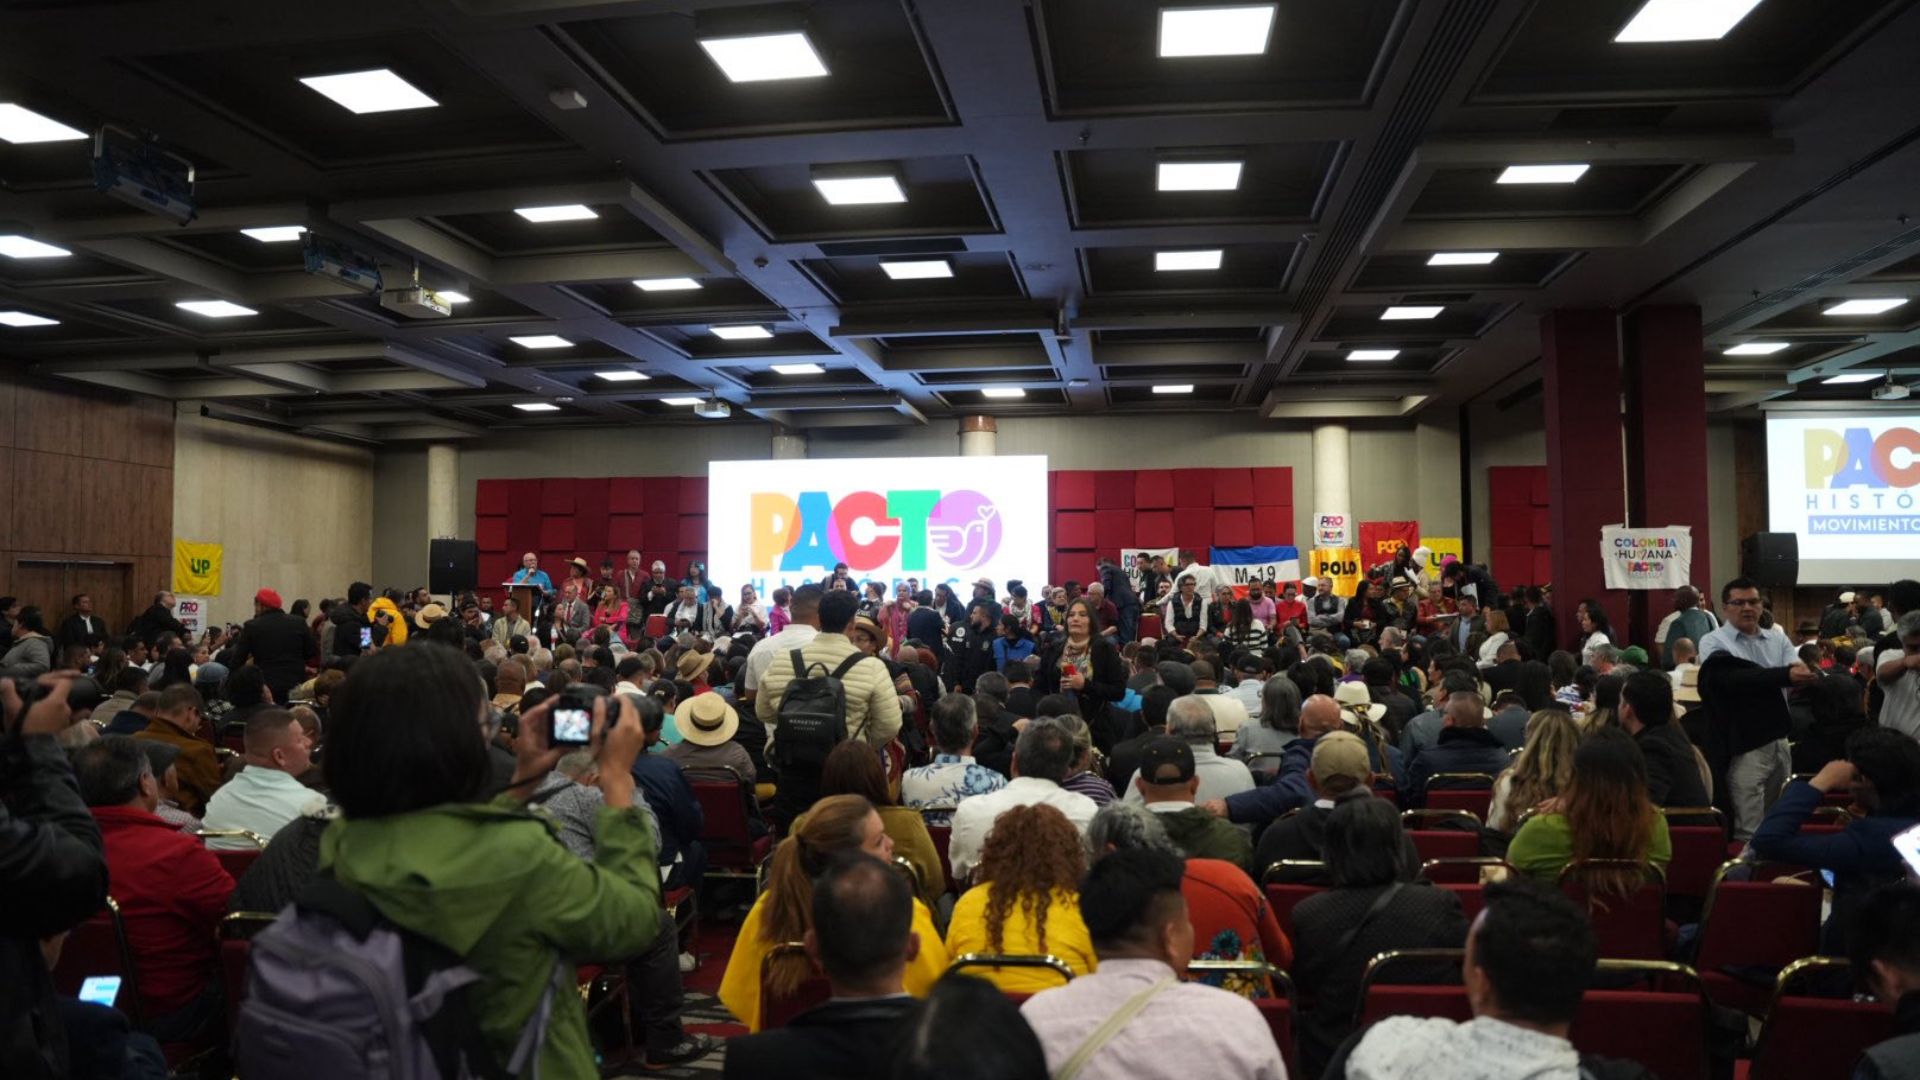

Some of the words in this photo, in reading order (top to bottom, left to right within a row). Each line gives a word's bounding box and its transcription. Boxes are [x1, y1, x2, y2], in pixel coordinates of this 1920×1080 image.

[1320, 515, 1344, 526] PRO
[750, 489, 1003, 572] PACTO
[1614, 538, 1677, 547] COLOMBIA
[1431, 552, 1458, 567] U
[190, 558, 211, 575] UP
[1320, 561, 1357, 575] POLO
[1627, 561, 1664, 572] PACTO
[180, 601, 198, 612] PRO
